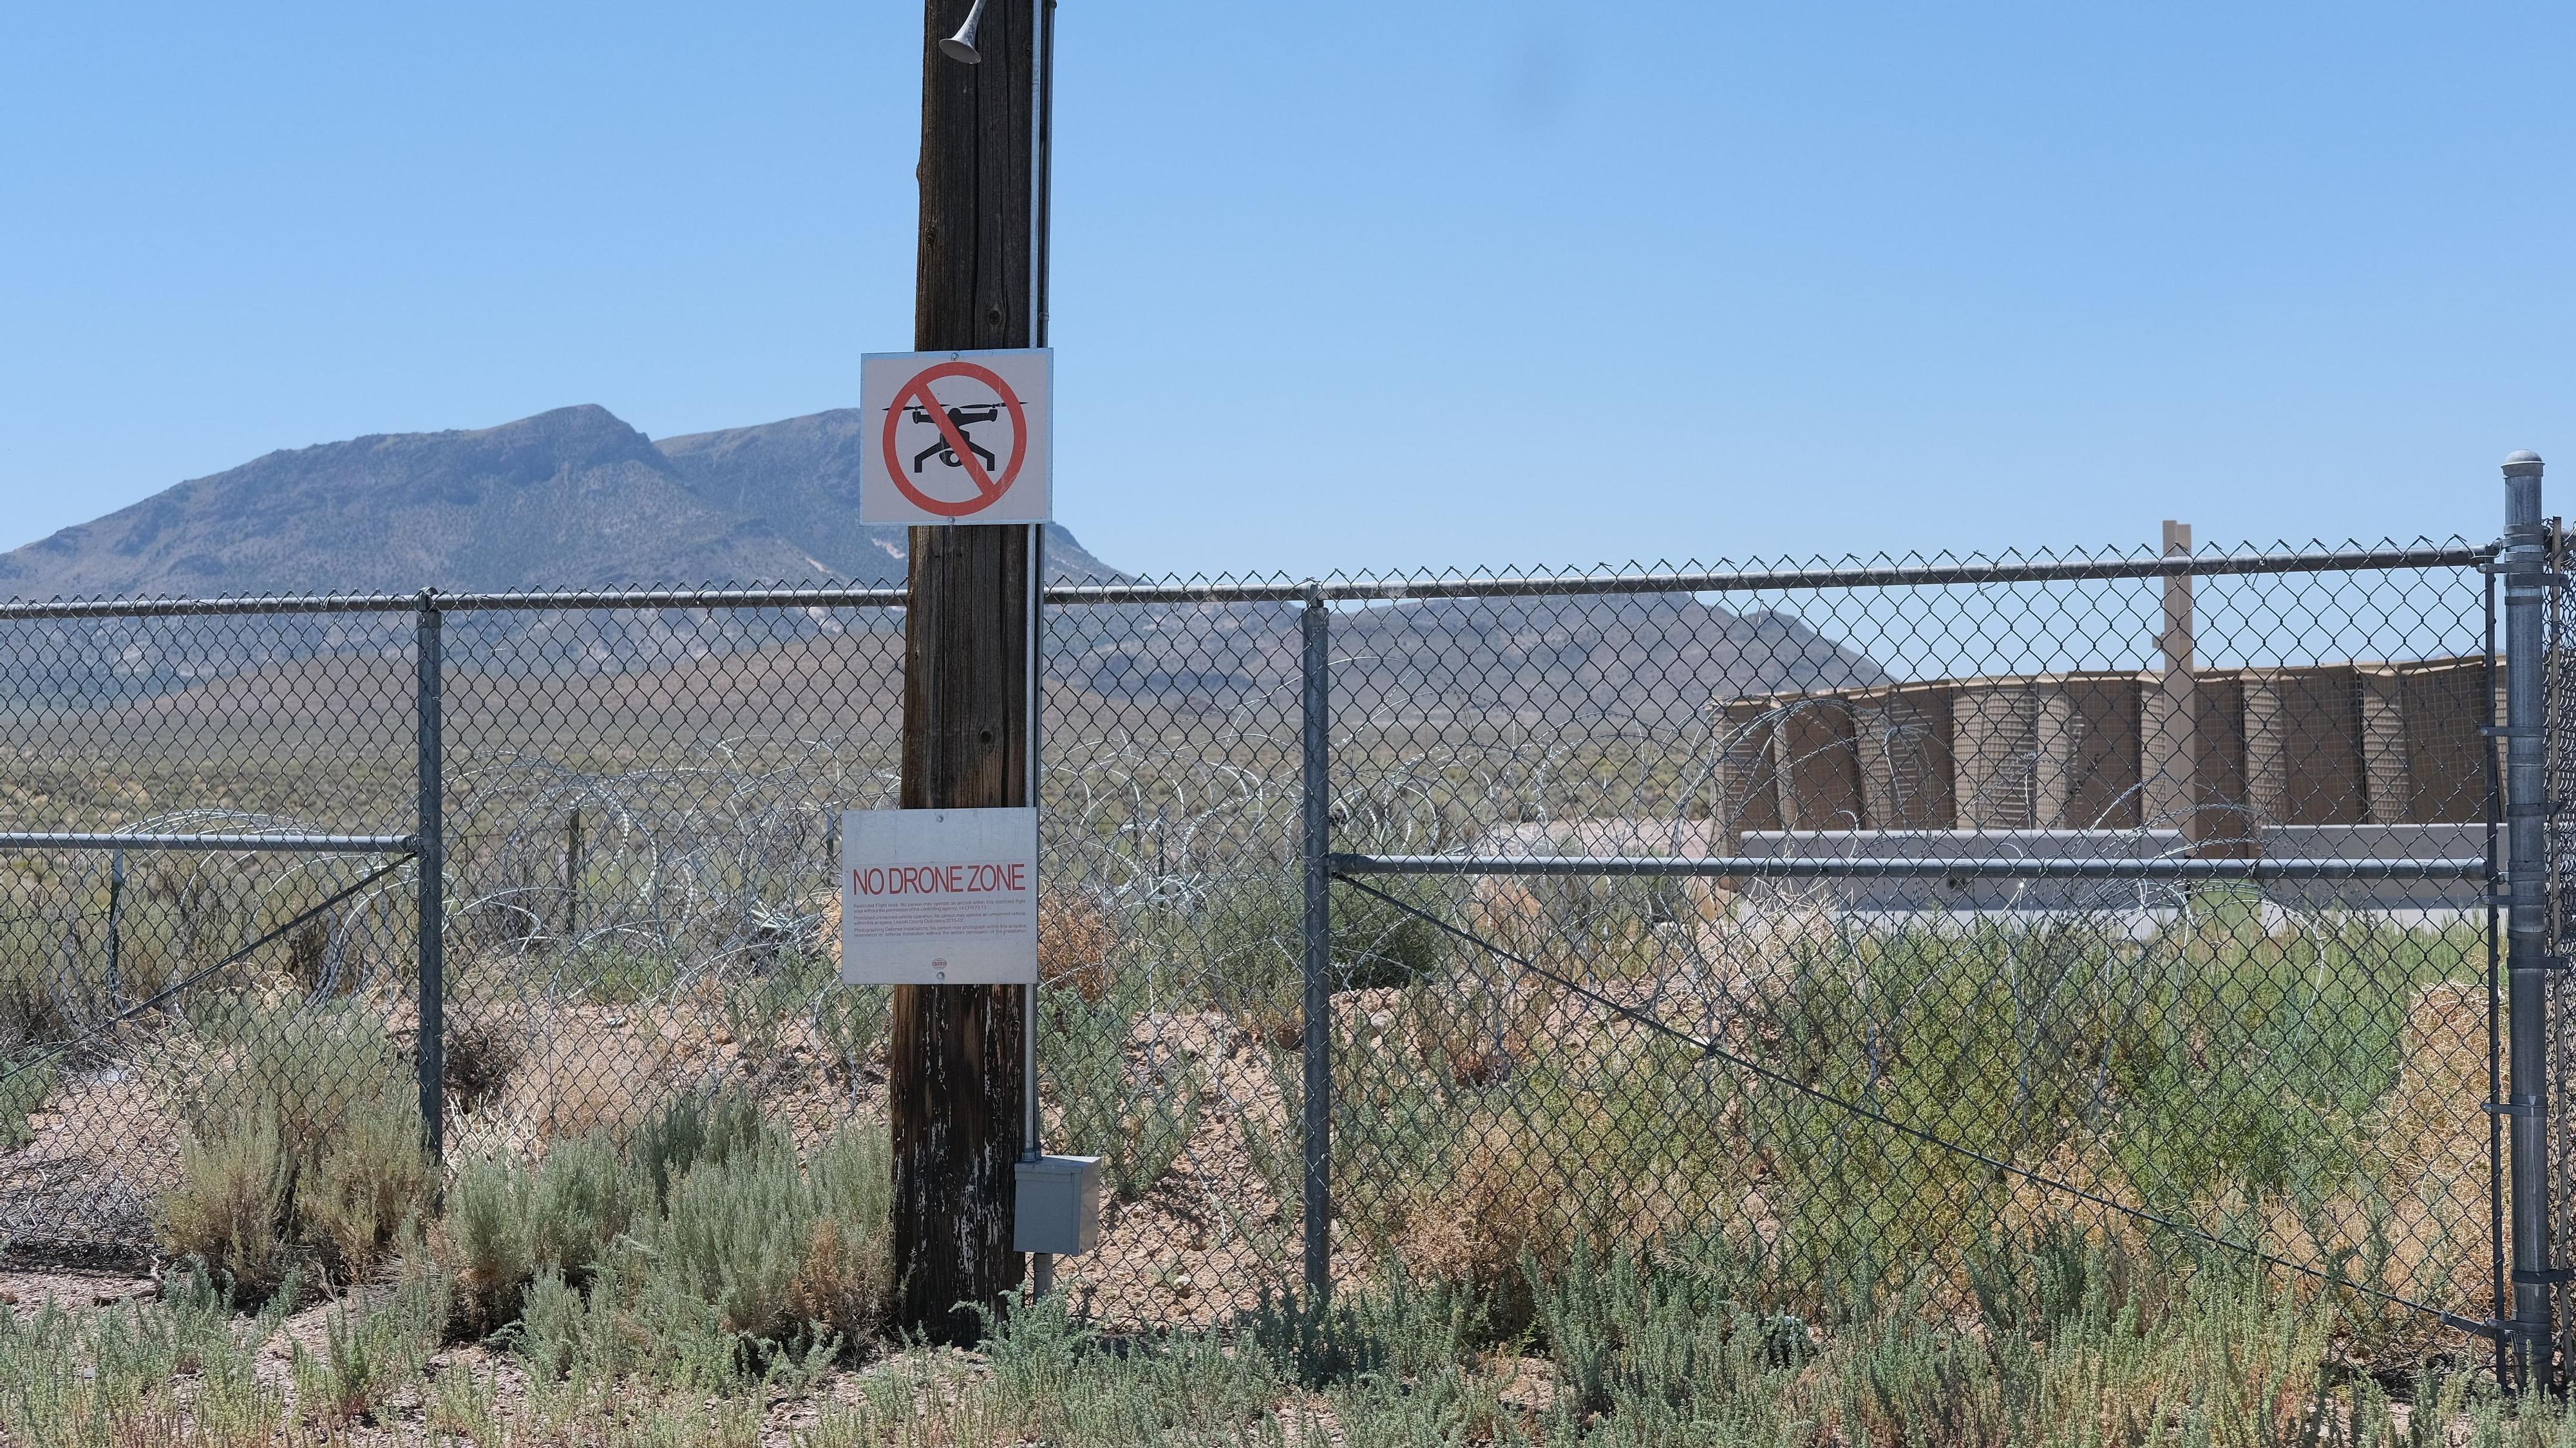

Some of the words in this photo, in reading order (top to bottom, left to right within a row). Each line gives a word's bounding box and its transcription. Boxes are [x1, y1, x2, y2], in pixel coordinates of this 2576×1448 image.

[853, 868, 884, 895] NO
[889, 865, 963, 894] DRONE
[967, 863, 1025, 892] ZONE
